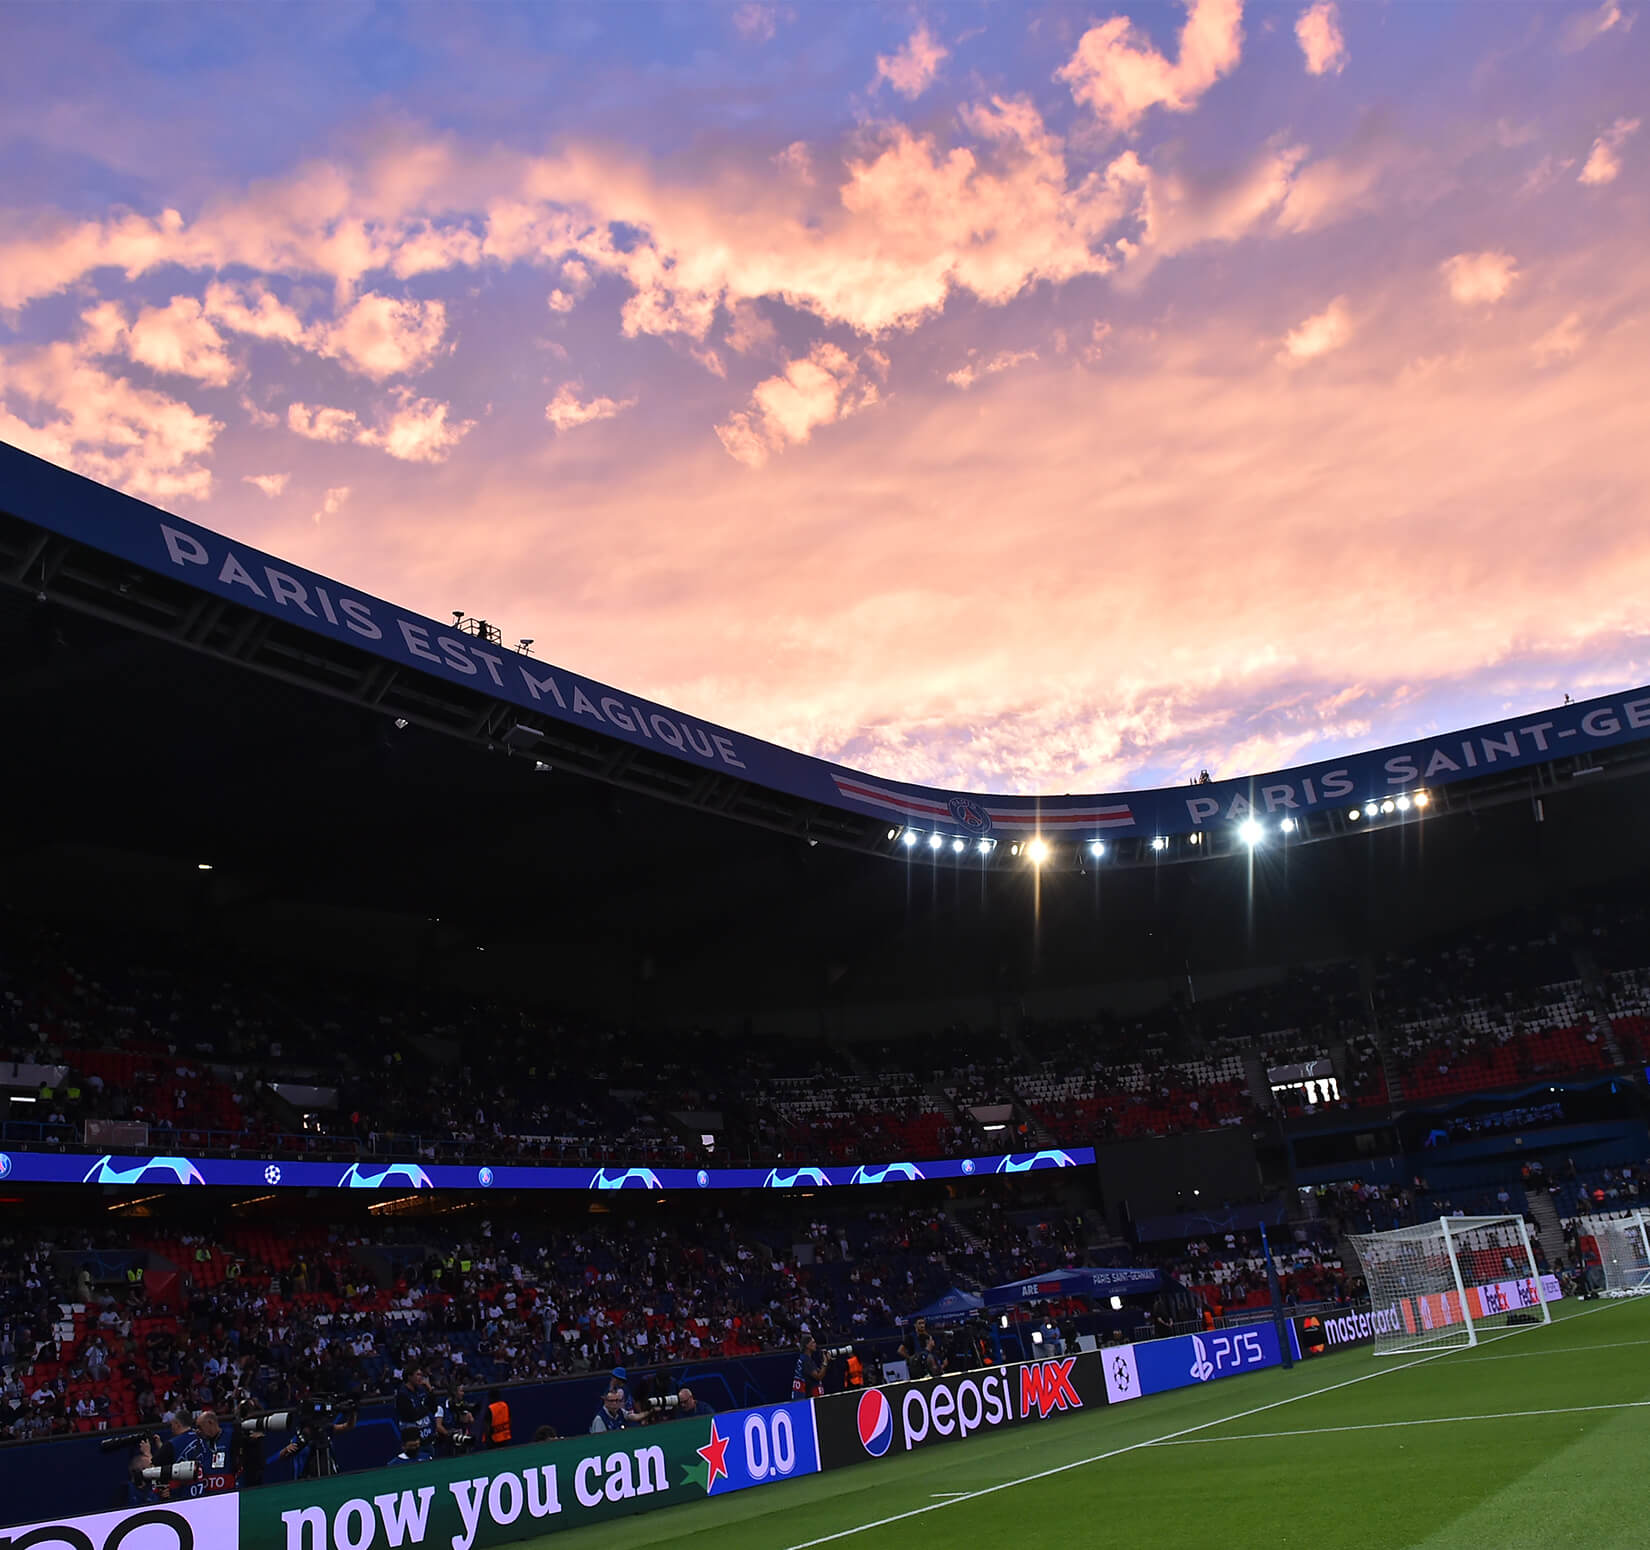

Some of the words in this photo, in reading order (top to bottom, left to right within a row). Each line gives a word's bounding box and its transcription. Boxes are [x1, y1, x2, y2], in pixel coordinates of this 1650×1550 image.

[160, 523, 383, 640] PARIS
[397, 618, 504, 687] EST
[518, 665, 747, 769] MAGIQUE
[1185, 769, 1354, 825] PARIS
[1212, 1332, 1263, 1370] PS5
[1324, 1302, 1401, 1345] mastercard
[902, 1366, 1014, 1450] pepsi
[1019, 1357, 1083, 1419] MAX
[744, 1408, 796, 1480] 0.0
[281, 1486, 435, 1550] now
[448, 1464, 562, 1550] you
[574, 1445, 670, 1507] can
